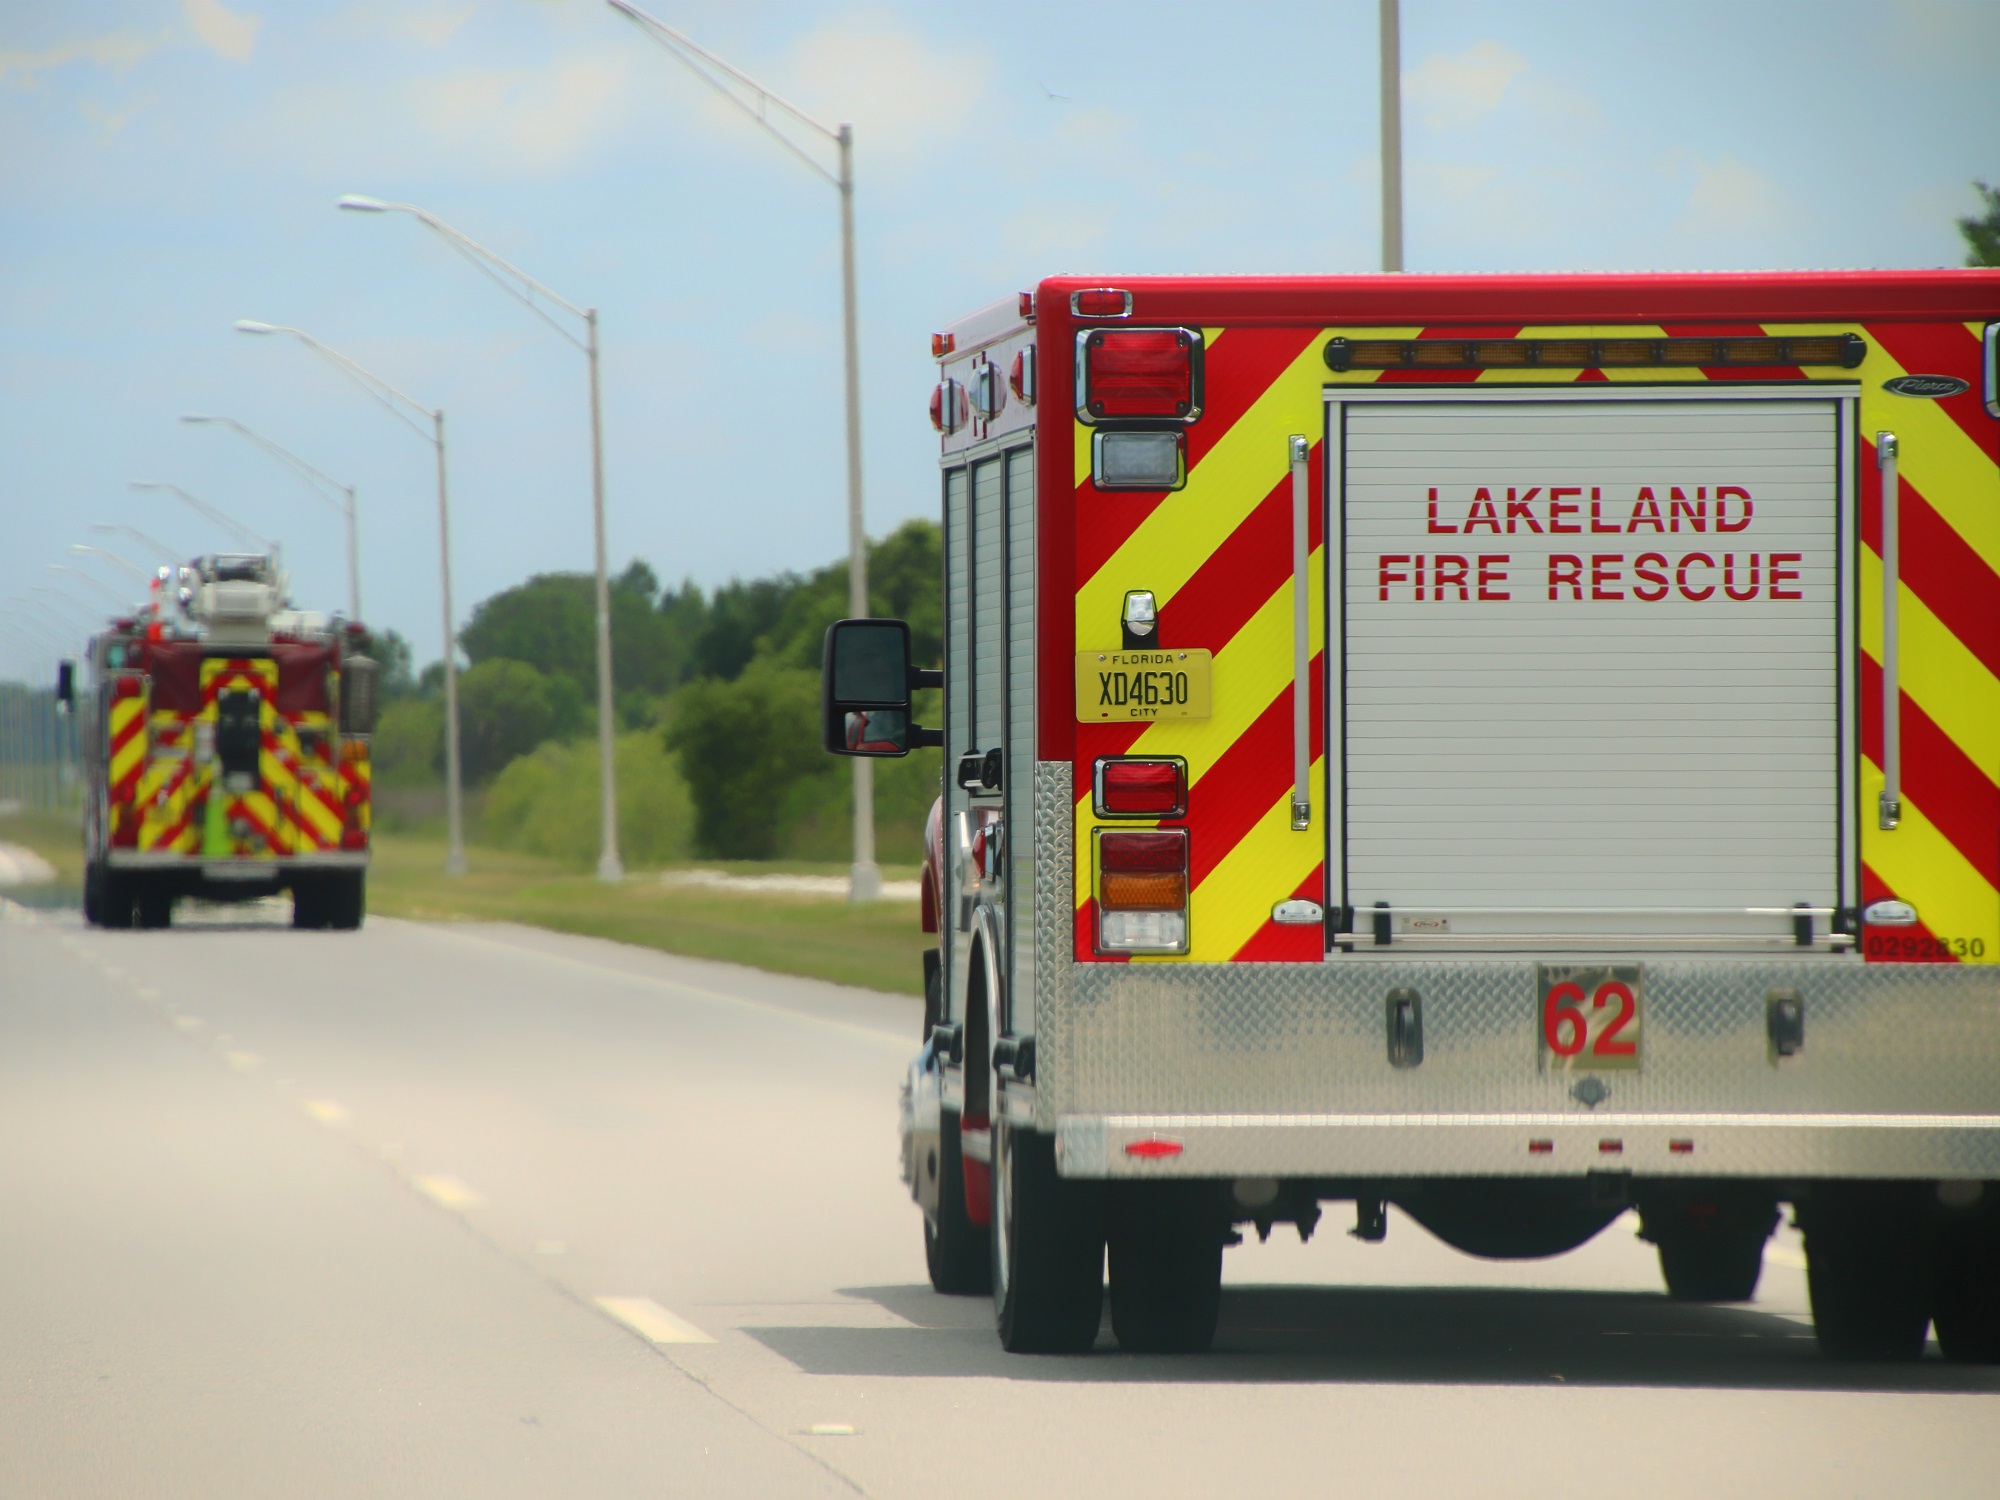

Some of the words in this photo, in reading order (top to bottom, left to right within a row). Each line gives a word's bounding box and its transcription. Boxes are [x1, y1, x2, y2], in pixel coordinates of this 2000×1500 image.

[1427, 486, 1754, 534] LAKELAND
[1378, 553, 1511, 601] FIRE
[1548, 552, 1803, 601] RESCUE
[1112, 654, 1174, 665] FLORIDA
[1099, 671, 1188, 706] XD4630
[1130, 708, 1158, 717] CITY
[1868, 935, 1985, 957] 0292830
[1543, 981, 1636, 1056] 62
